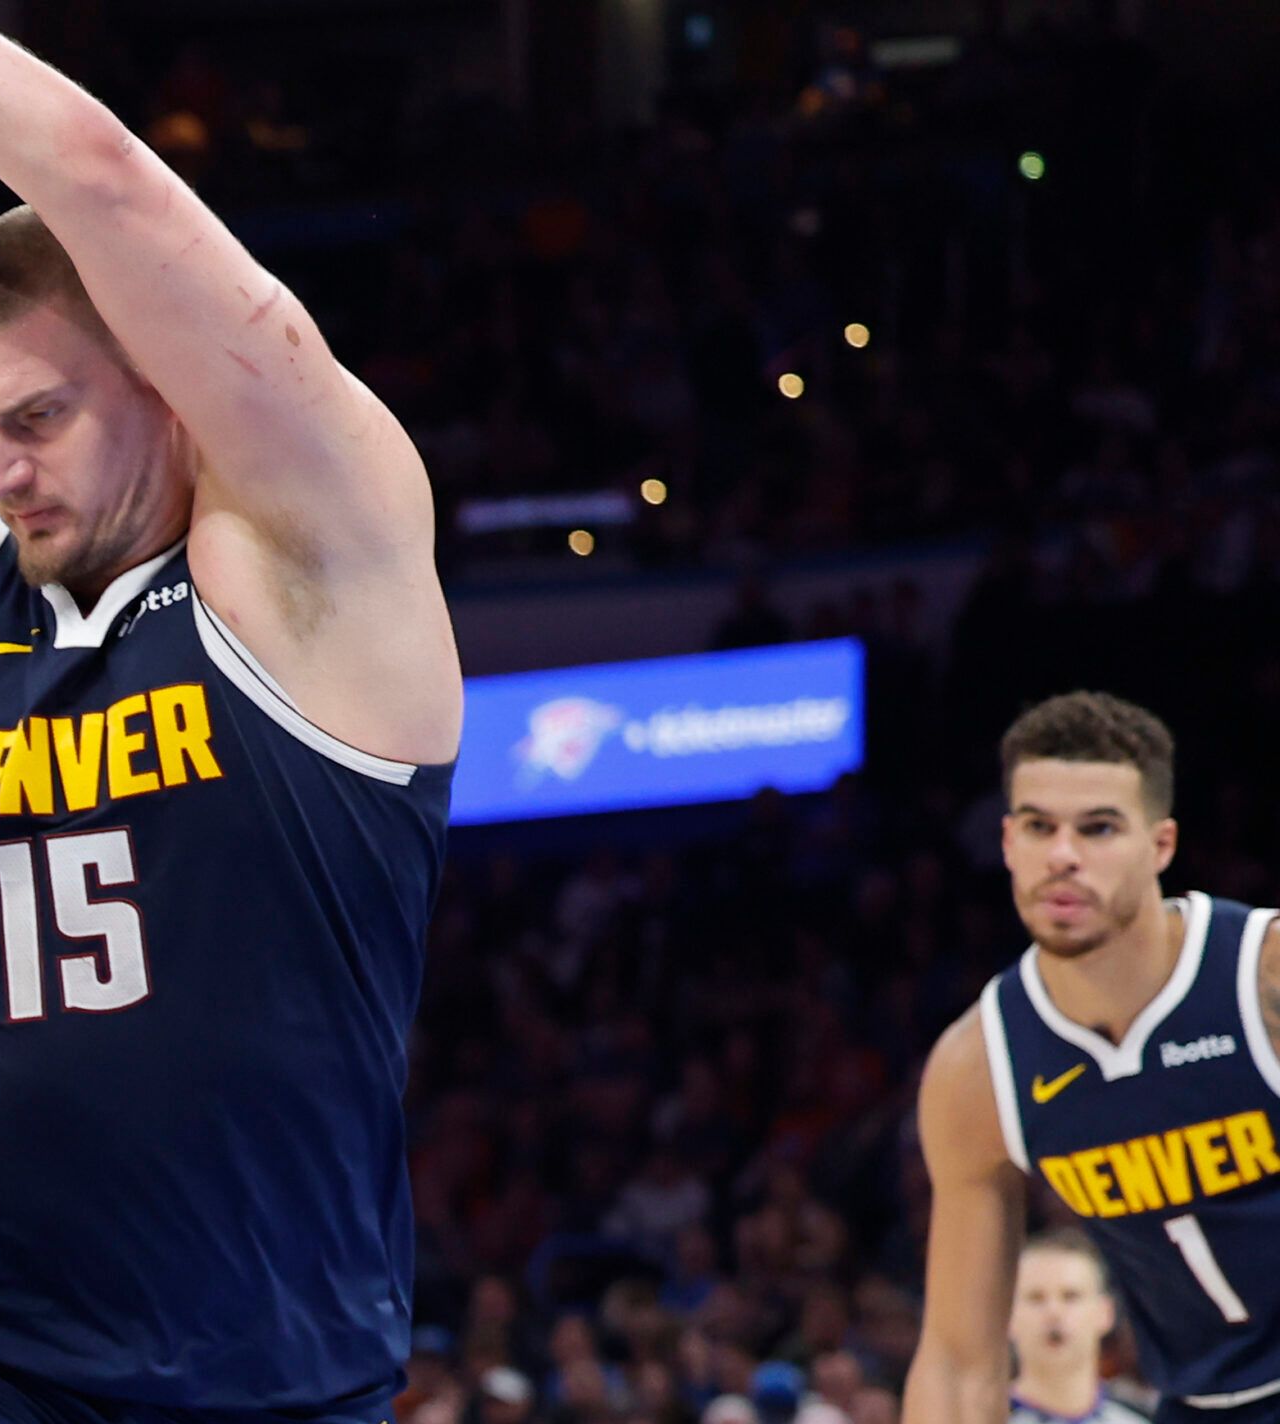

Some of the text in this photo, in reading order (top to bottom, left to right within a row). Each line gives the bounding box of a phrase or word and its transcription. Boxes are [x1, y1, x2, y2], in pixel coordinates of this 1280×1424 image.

[1160, 1034, 1236, 1068] ibotta
[1039, 1110, 1280, 1219] DENVER
[1163, 1213, 1250, 1323] 1
